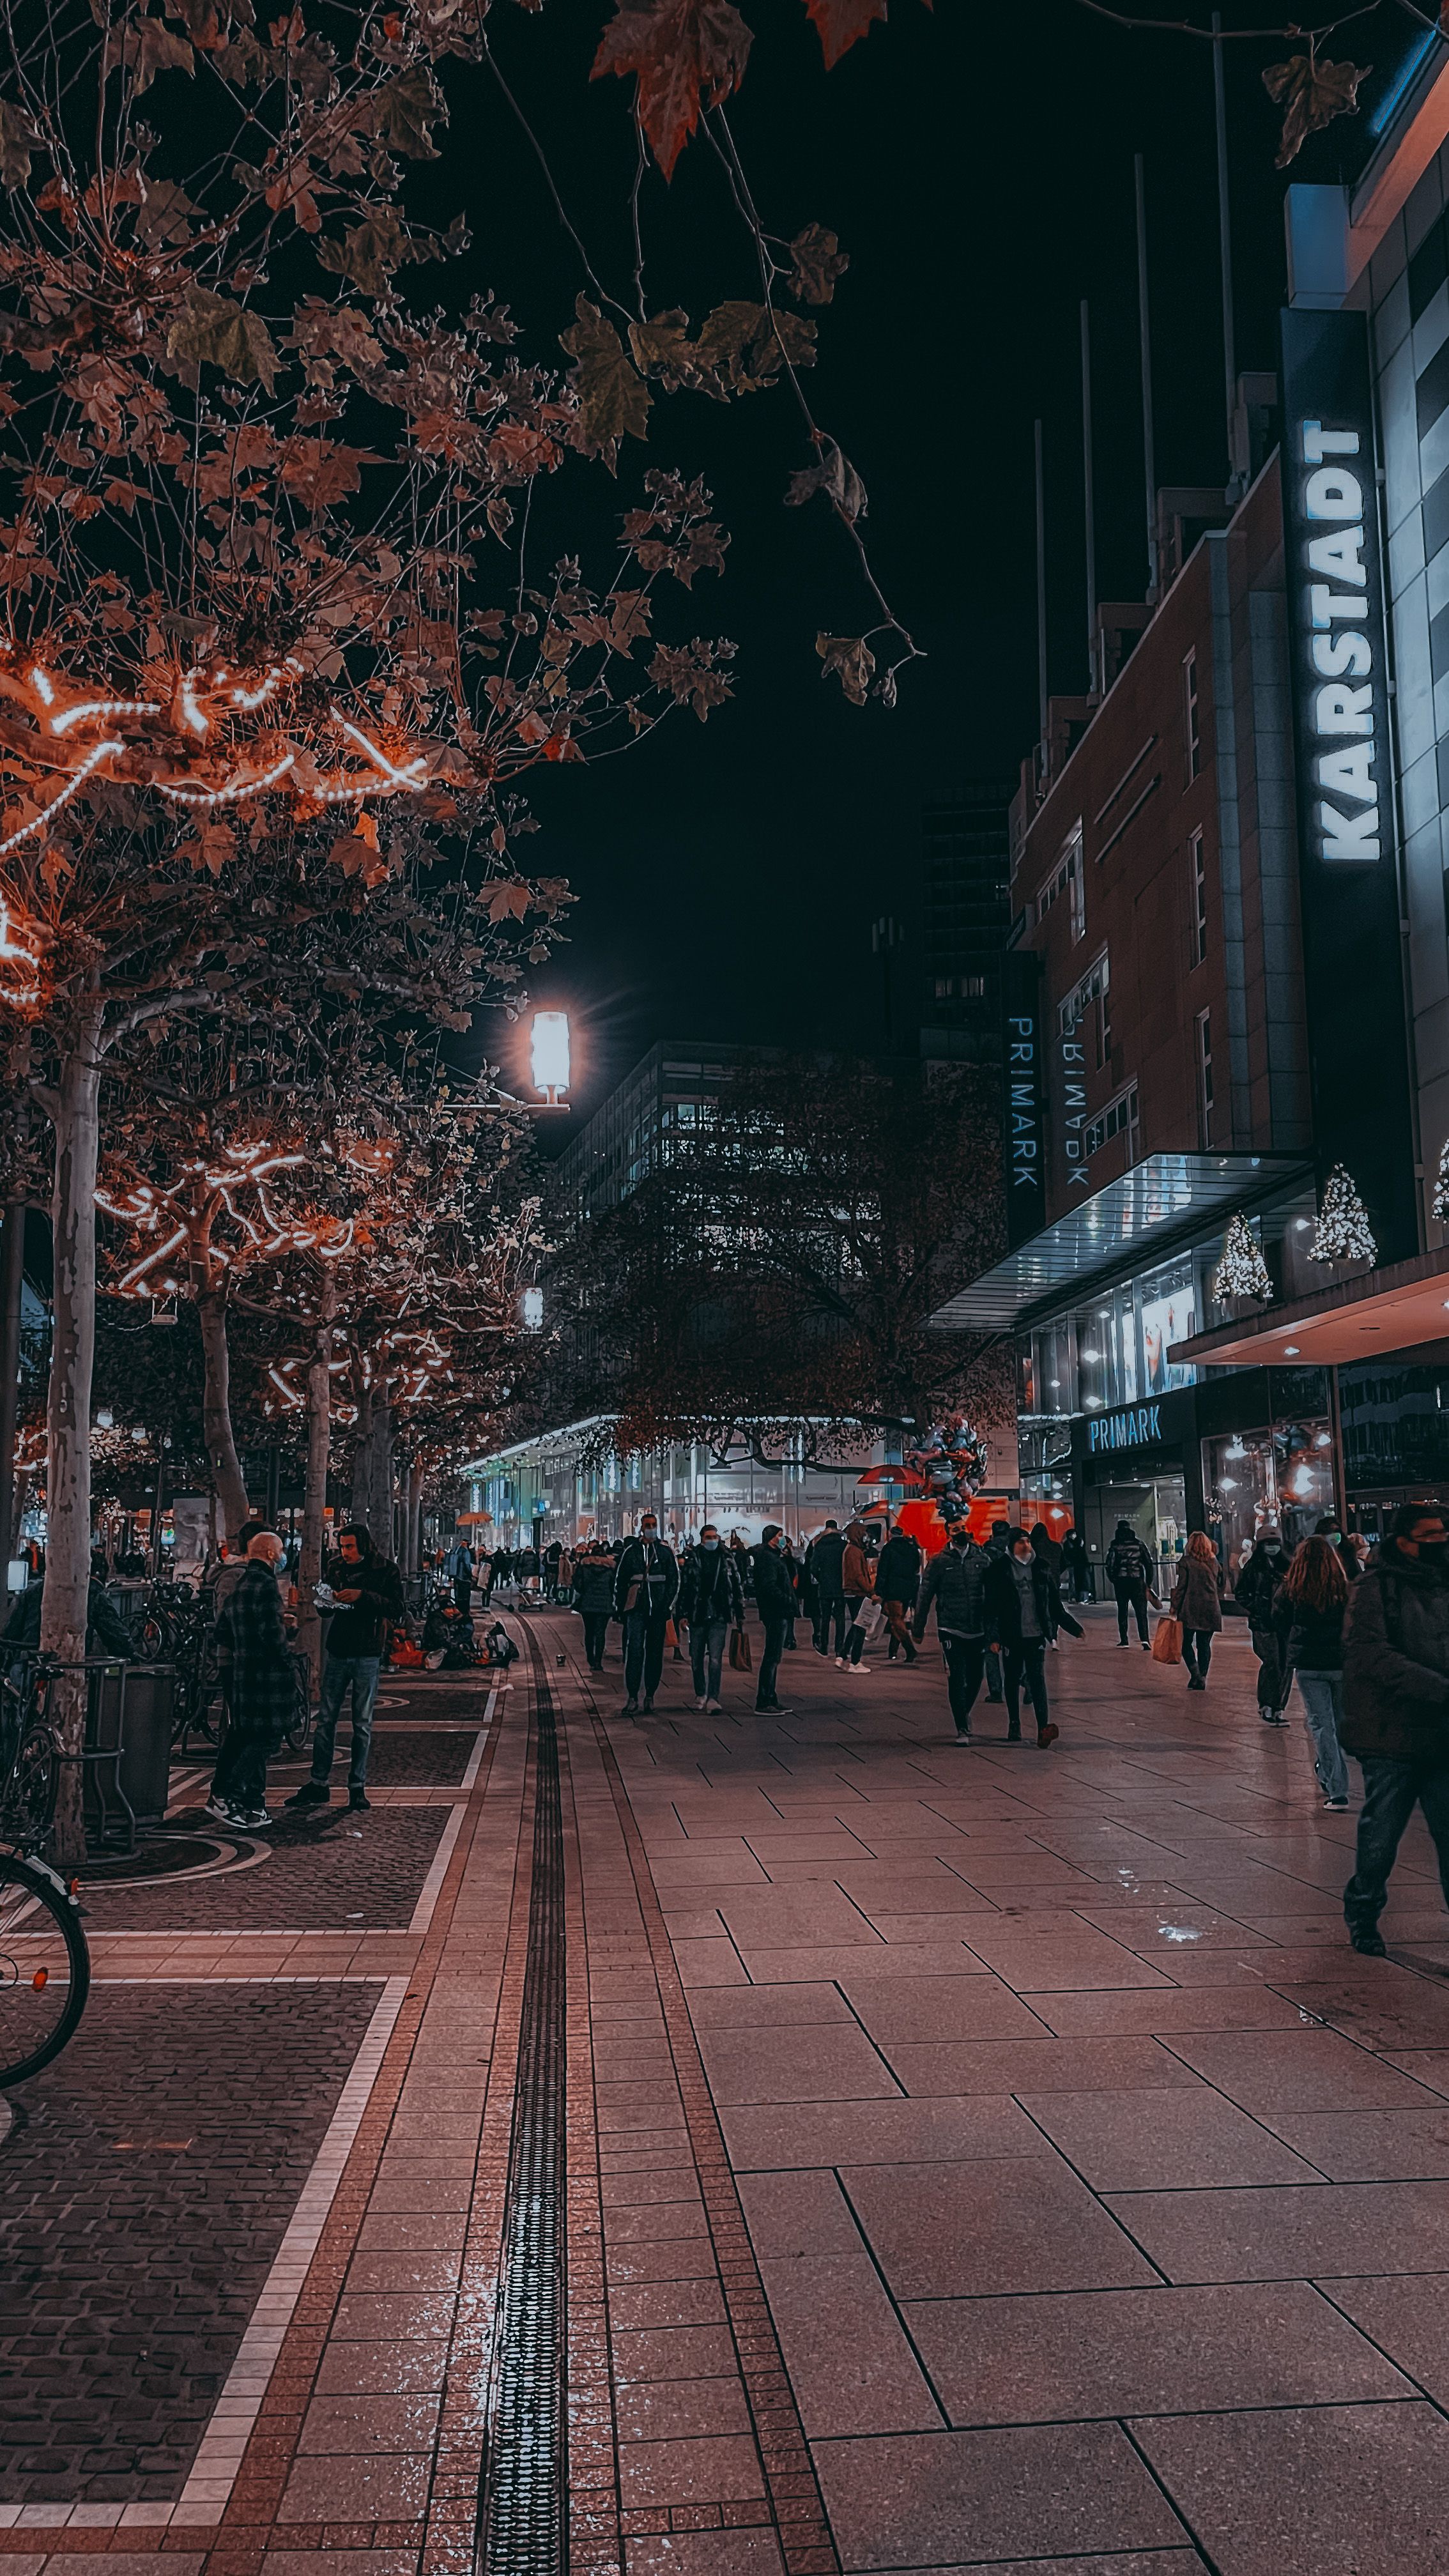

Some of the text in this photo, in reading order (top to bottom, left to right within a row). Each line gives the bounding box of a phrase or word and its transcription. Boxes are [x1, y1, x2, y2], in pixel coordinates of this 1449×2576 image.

[1303, 420, 1380, 861] KARSTADT
[1009, 1018, 1037, 1185] PRIMARK
[1090, 1405, 1162, 1452] PRIMARK
